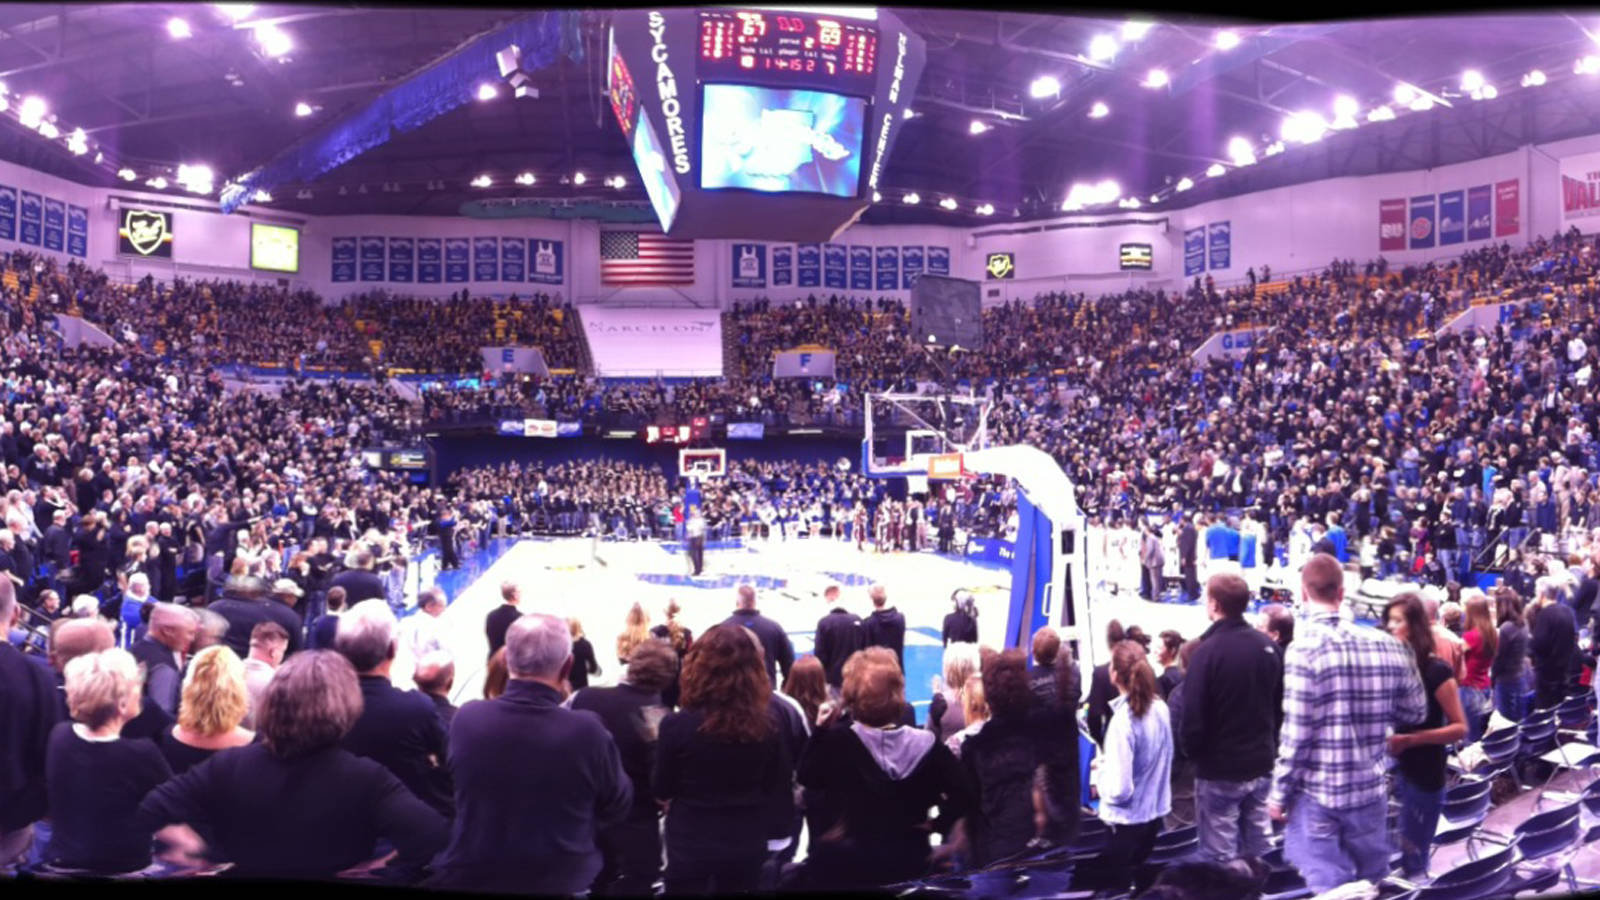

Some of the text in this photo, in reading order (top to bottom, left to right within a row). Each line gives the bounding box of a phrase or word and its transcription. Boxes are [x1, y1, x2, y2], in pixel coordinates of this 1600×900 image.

[804, 37, 815, 49] 2
[648, 11, 691, 174] SYCAMORES
[869, 113, 893, 190] CENTER
[1562, 174, 1600, 212] VAL
[502, 349, 514, 363] E
[800, 353, 812, 367] F
